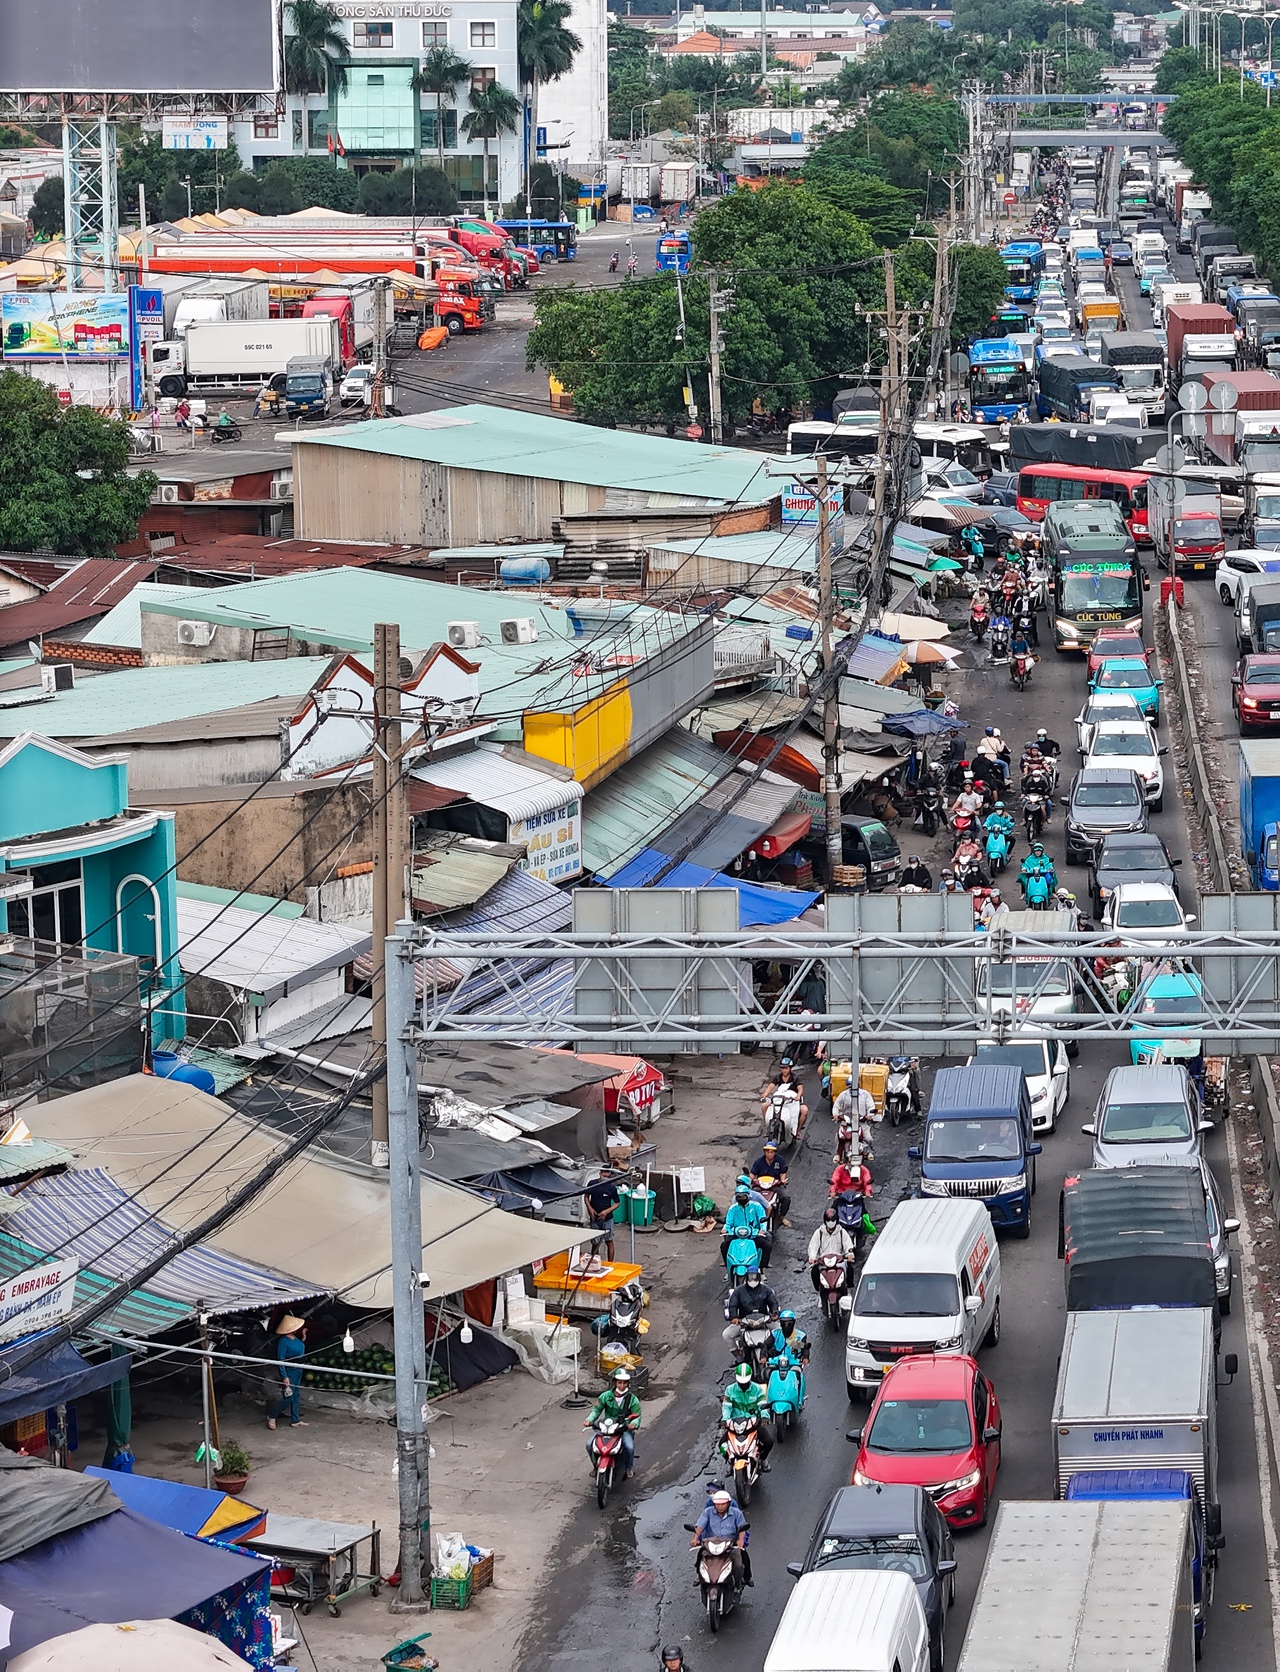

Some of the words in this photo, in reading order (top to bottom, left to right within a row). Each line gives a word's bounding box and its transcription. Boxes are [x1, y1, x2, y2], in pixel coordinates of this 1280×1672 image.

[1076, 611, 1095, 621] CÚC
[1097, 611, 1122, 621] TÙNG
[557, 807, 566, 820] XE
[11, 1271, 61, 1298] EMBRAYAGE
[1121, 1429, 1139, 1441] PHÁT
[1140, 1429, 1164, 1440] NHANH
